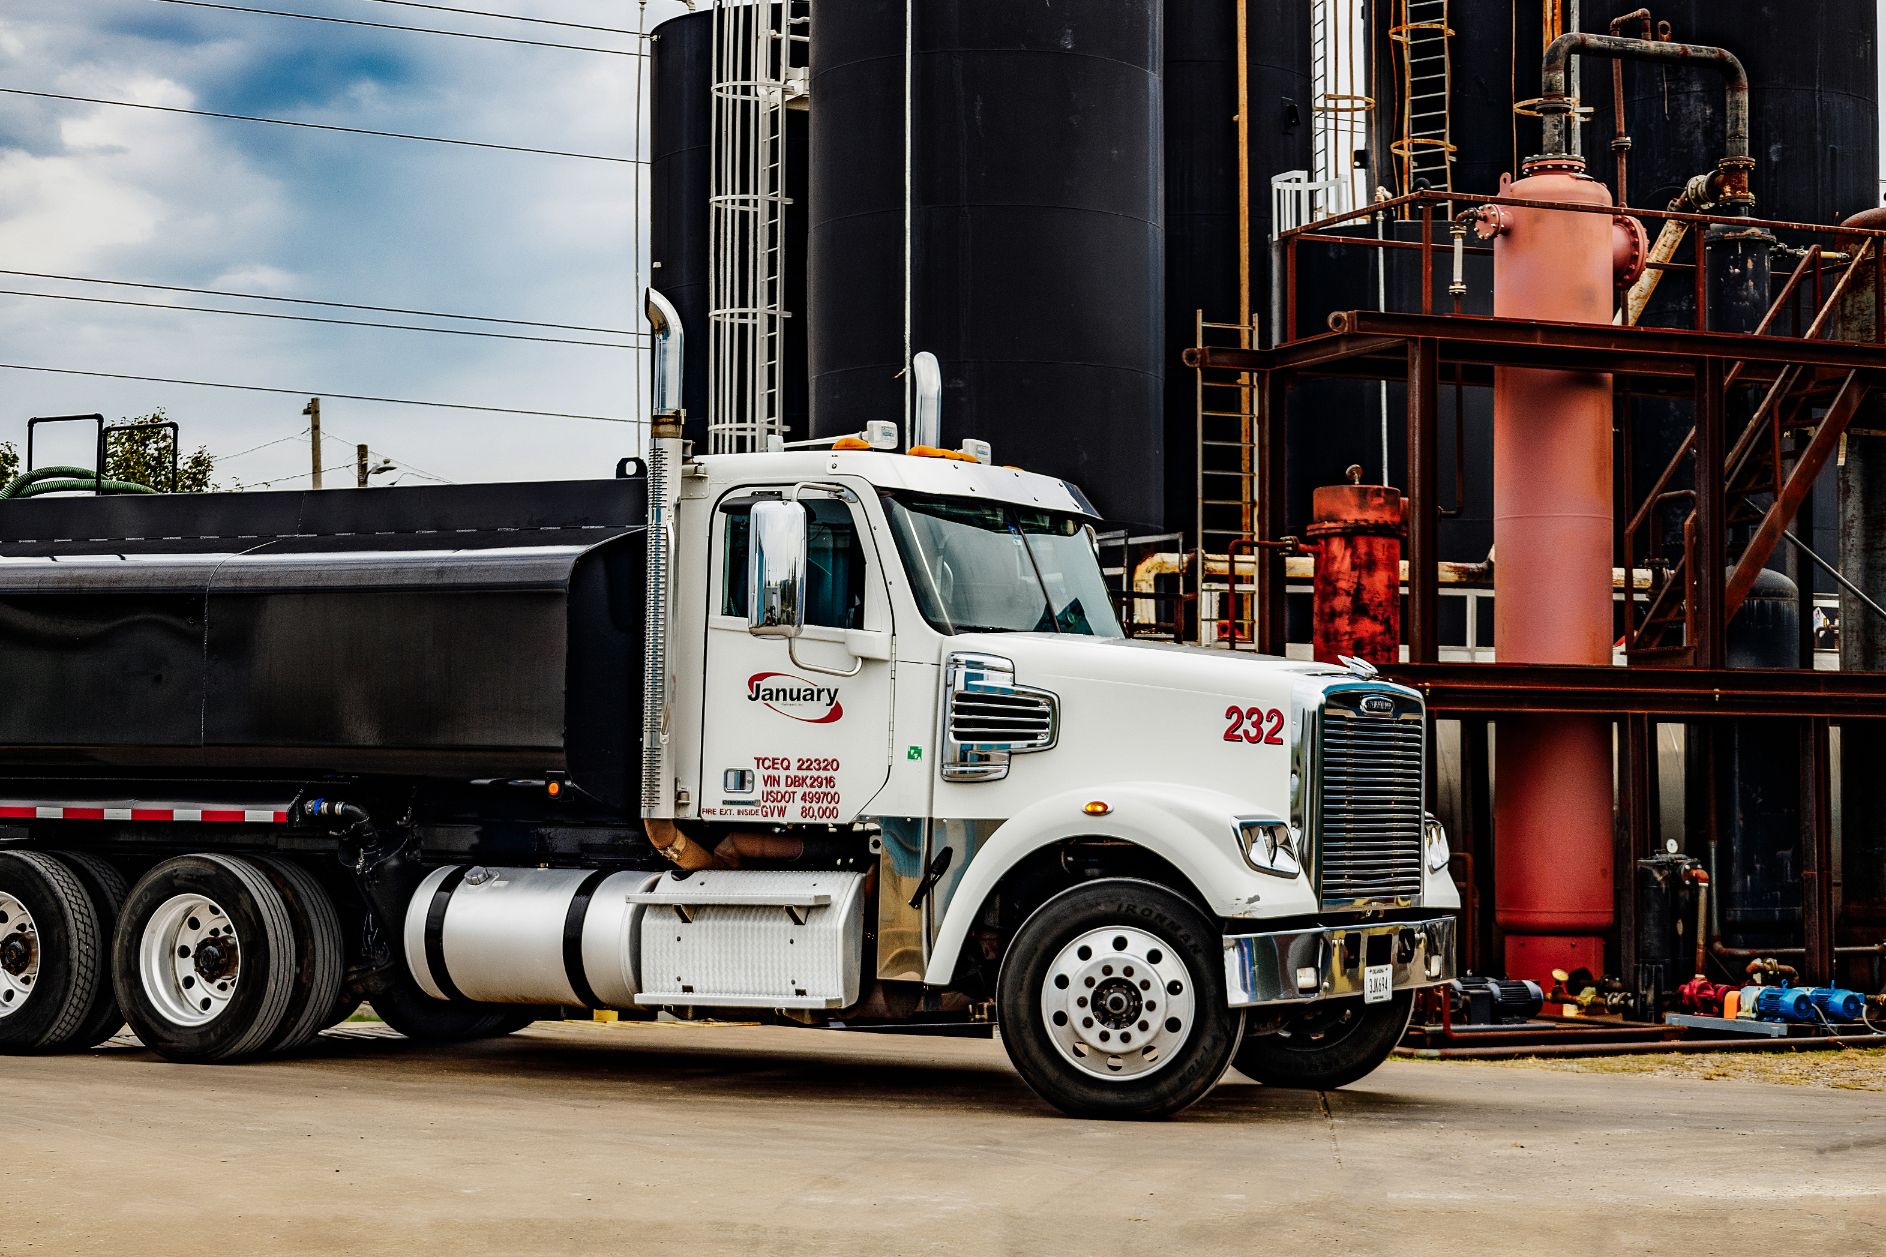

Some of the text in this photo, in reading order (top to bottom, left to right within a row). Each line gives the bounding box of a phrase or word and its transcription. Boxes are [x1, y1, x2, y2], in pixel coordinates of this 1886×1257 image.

[747, 683, 839, 707] January
[1223, 706, 1284, 745] 232
[754, 757, 839, 771] TCEQ 22320
[763, 775, 835, 788] VIN DBK2916
[762, 790, 797, 803] USDOT
[801, 791, 840, 804] 499700
[702, 808, 717, 816] FIRE
[737, 808, 760, 816] INSIDE
[761, 805, 838, 821] GVW 80,000
[1117, 903, 1203, 954] IRONMAN
